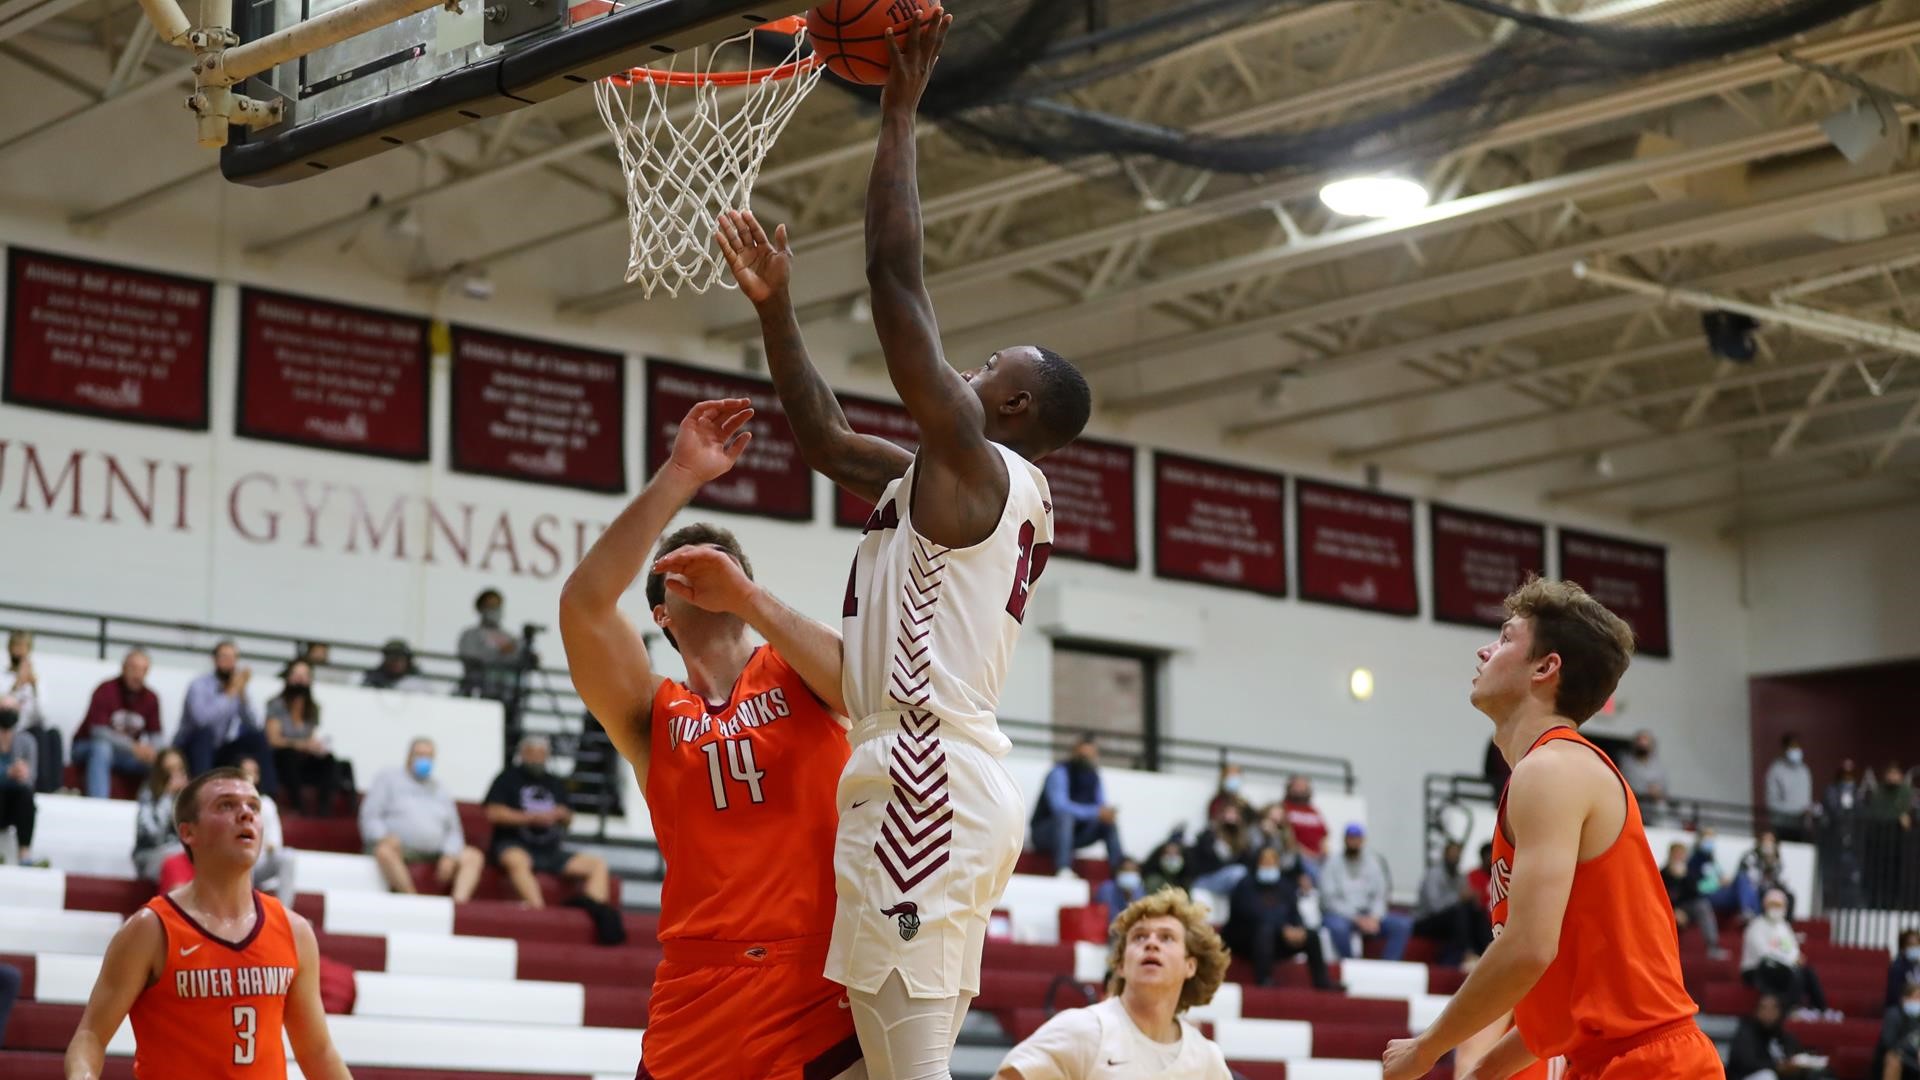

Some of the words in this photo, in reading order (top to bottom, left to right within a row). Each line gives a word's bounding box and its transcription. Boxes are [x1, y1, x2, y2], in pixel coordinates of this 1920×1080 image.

[0, 438, 193, 531] MNI
[228, 472, 608, 580] GYMNASI
[667, 712, 712, 751] RIVR
[701, 738, 765, 811] 14
[175, 967, 233, 998] RIVER
[231, 1004, 257, 1066] 3
